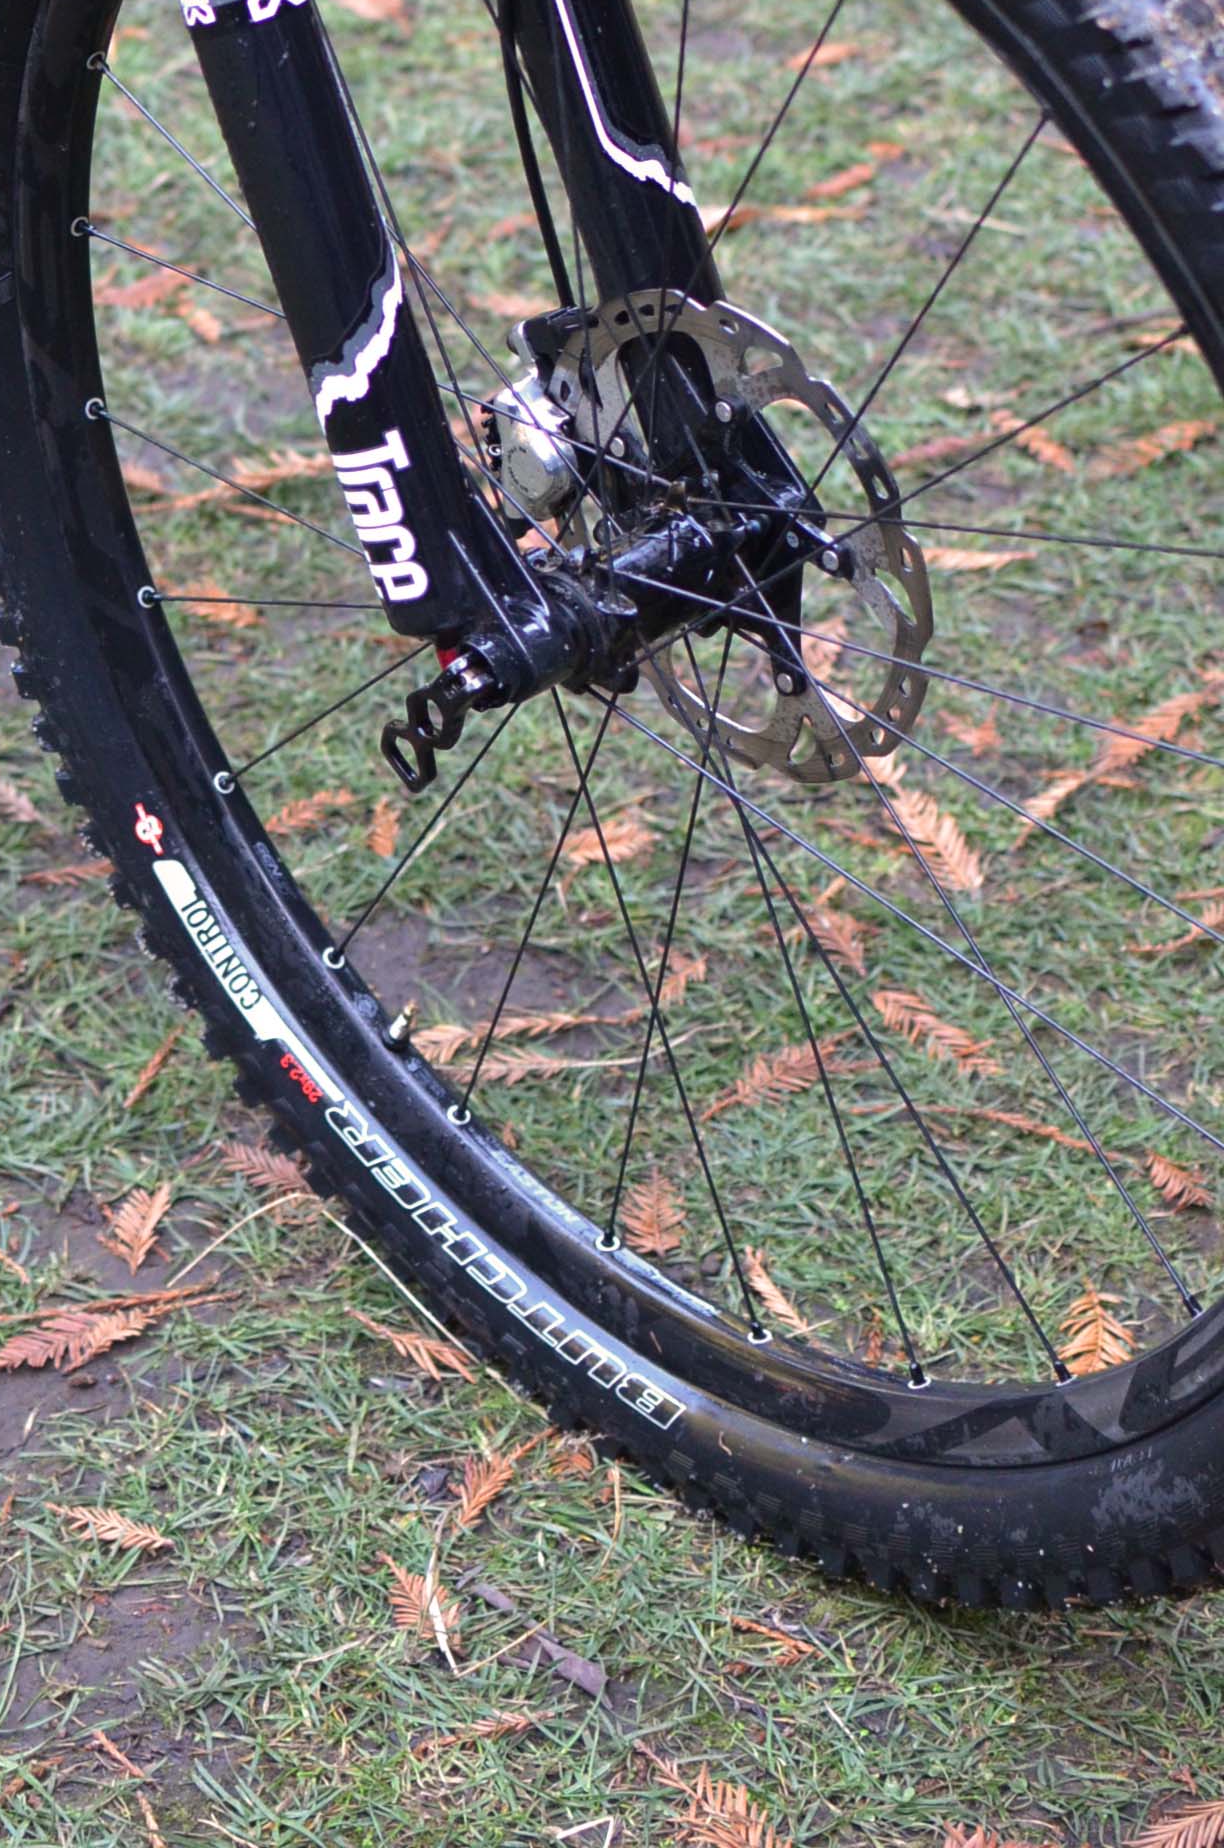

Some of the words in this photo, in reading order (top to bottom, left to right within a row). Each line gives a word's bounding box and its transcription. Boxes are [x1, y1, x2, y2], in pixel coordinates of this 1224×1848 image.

[331, 428, 429, 602] Trace
[181, 898, 262, 1011] CONTROL
[280, 1053, 324, 1104] 29x2.3
[325, 1099, 688, 1430] BUTCHER
